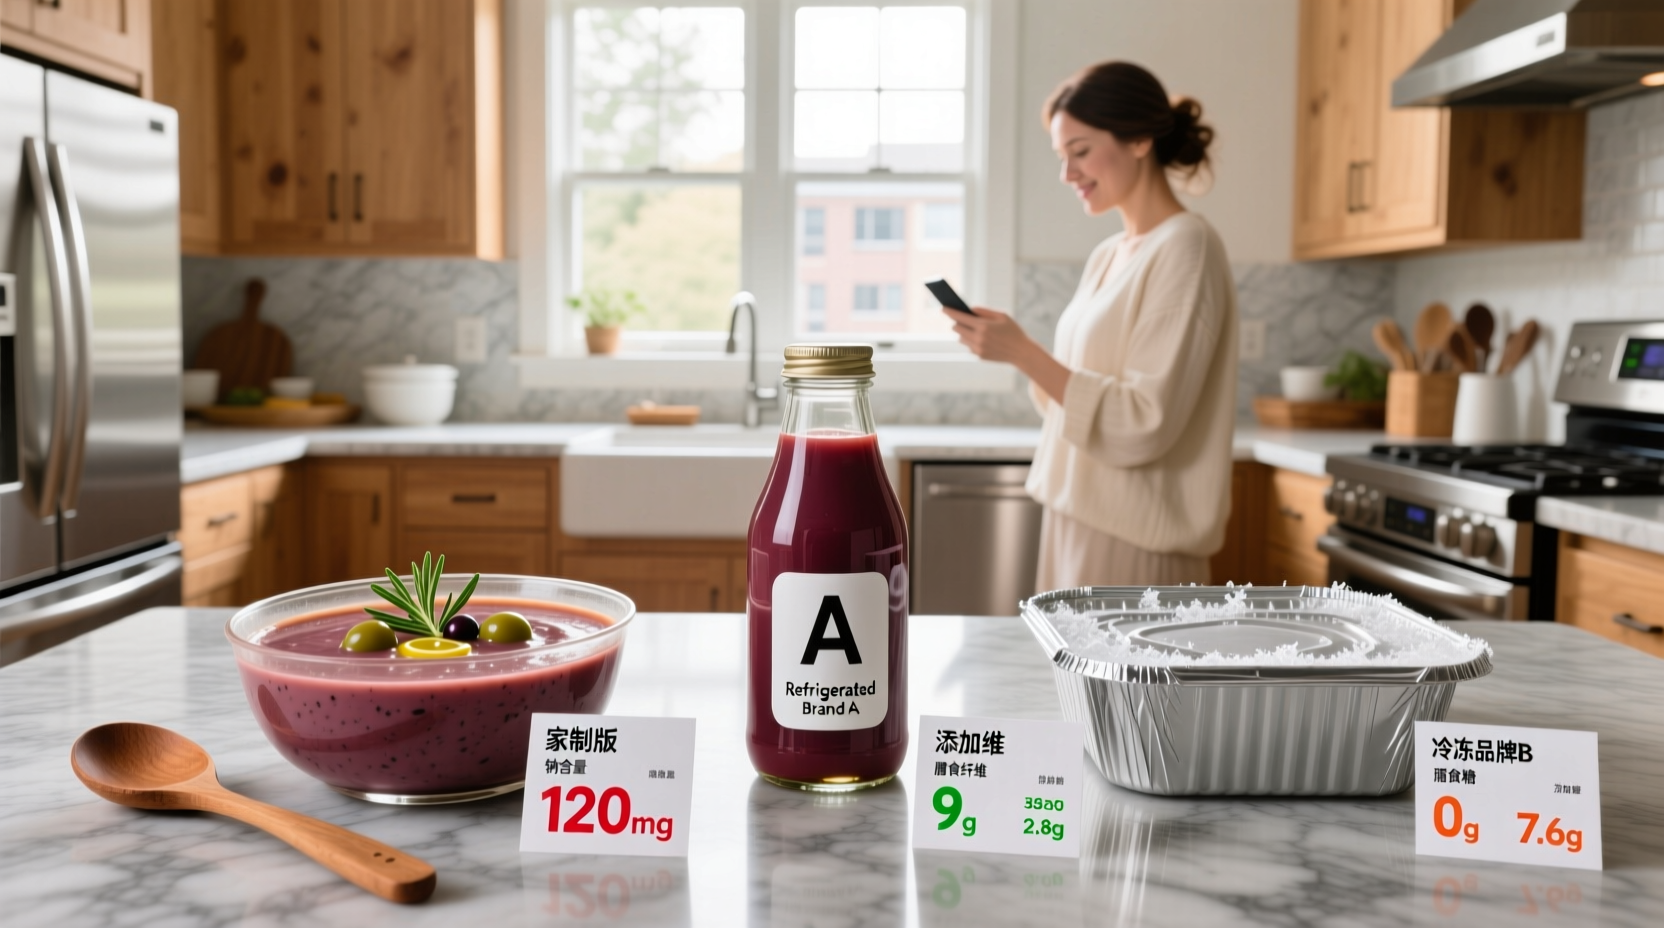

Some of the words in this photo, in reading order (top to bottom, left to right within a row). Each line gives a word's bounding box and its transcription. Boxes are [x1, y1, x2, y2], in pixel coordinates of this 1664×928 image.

[800, 595, 863, 665] A
[785, 680, 876, 701] Refrigerated
[802, 701, 845, 715] Brand
[848, 701, 860, 714] A
[545, 726, 618, 753] 家制版
[935, 729, 1006, 755] 添加维
[1432, 736, 1534, 764] 冷冻品牌B
[541, 786, 674, 842] 120mg
[932, 786, 977, 837] 9g
[1433, 795, 1479, 844] 0g
[1023, 818, 1065, 841] 2.8g
[1517, 812, 1583, 853] 7.6g
